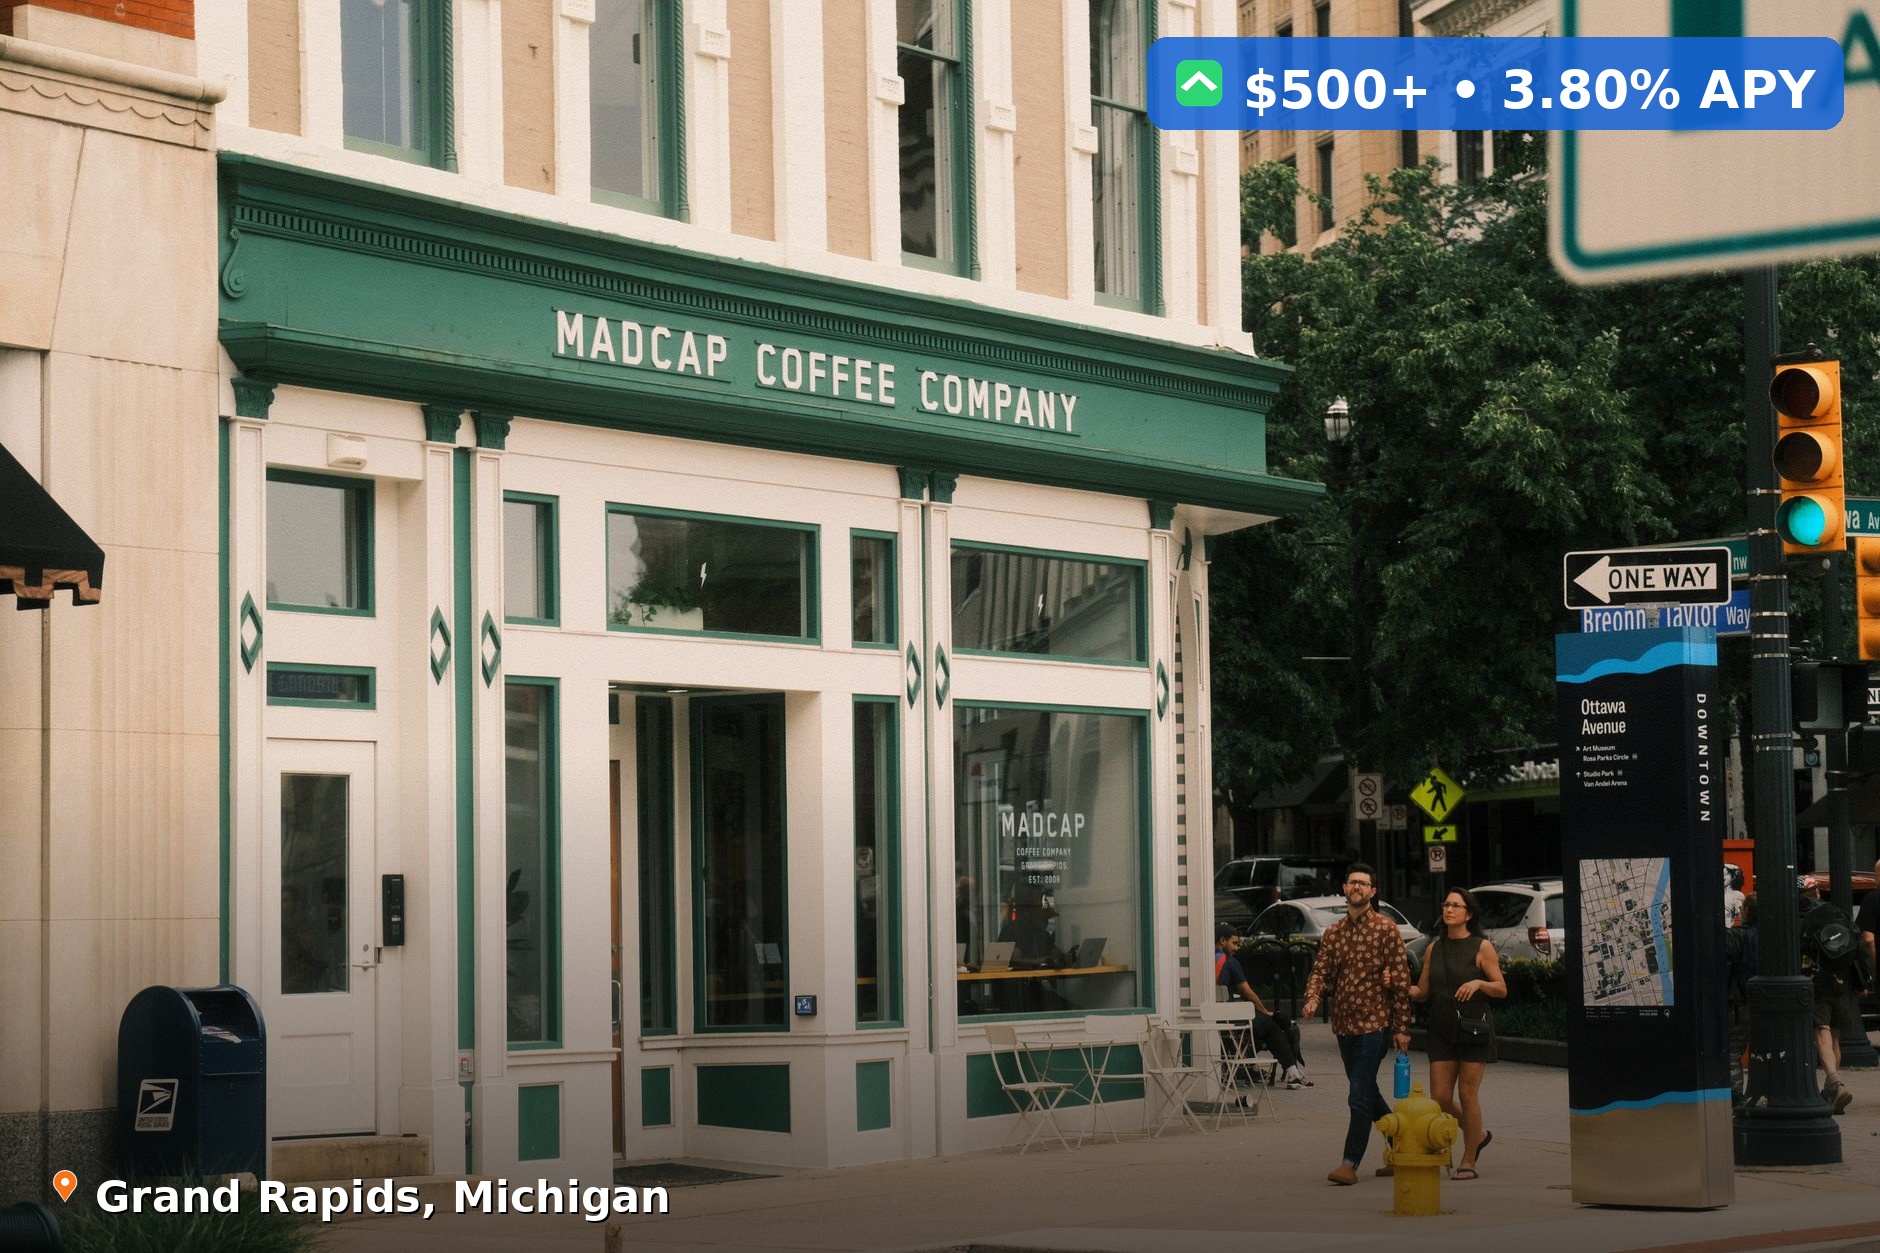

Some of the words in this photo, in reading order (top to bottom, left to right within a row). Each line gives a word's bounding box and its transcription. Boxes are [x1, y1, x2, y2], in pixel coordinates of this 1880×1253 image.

[556, 310, 727, 377] MADCAP
[756, 343, 896, 404] COFFEE
[920, 370, 1078, 432] COMPANY
[1733, 556, 1748, 571] nw
[1608, 568, 1656, 590] ONE
[1663, 566, 1711, 588] WAY
[1583, 608, 1647, 633] Breonn
[1726, 606, 1751, 629] Way
[1581, 698, 1626, 715] Ottawa
[1581, 719, 1626, 735] Avenue
[1696, 693, 1711, 821] DOWNTOWN
[1002, 812, 1085, 838] MADCAP
[1016, 847, 1040, 856] COFFEE
[1042, 847, 1072, 856] COMPANY
[1028, 875, 1043, 884] EST.
[1045, 875, 1060, 884] 2008
